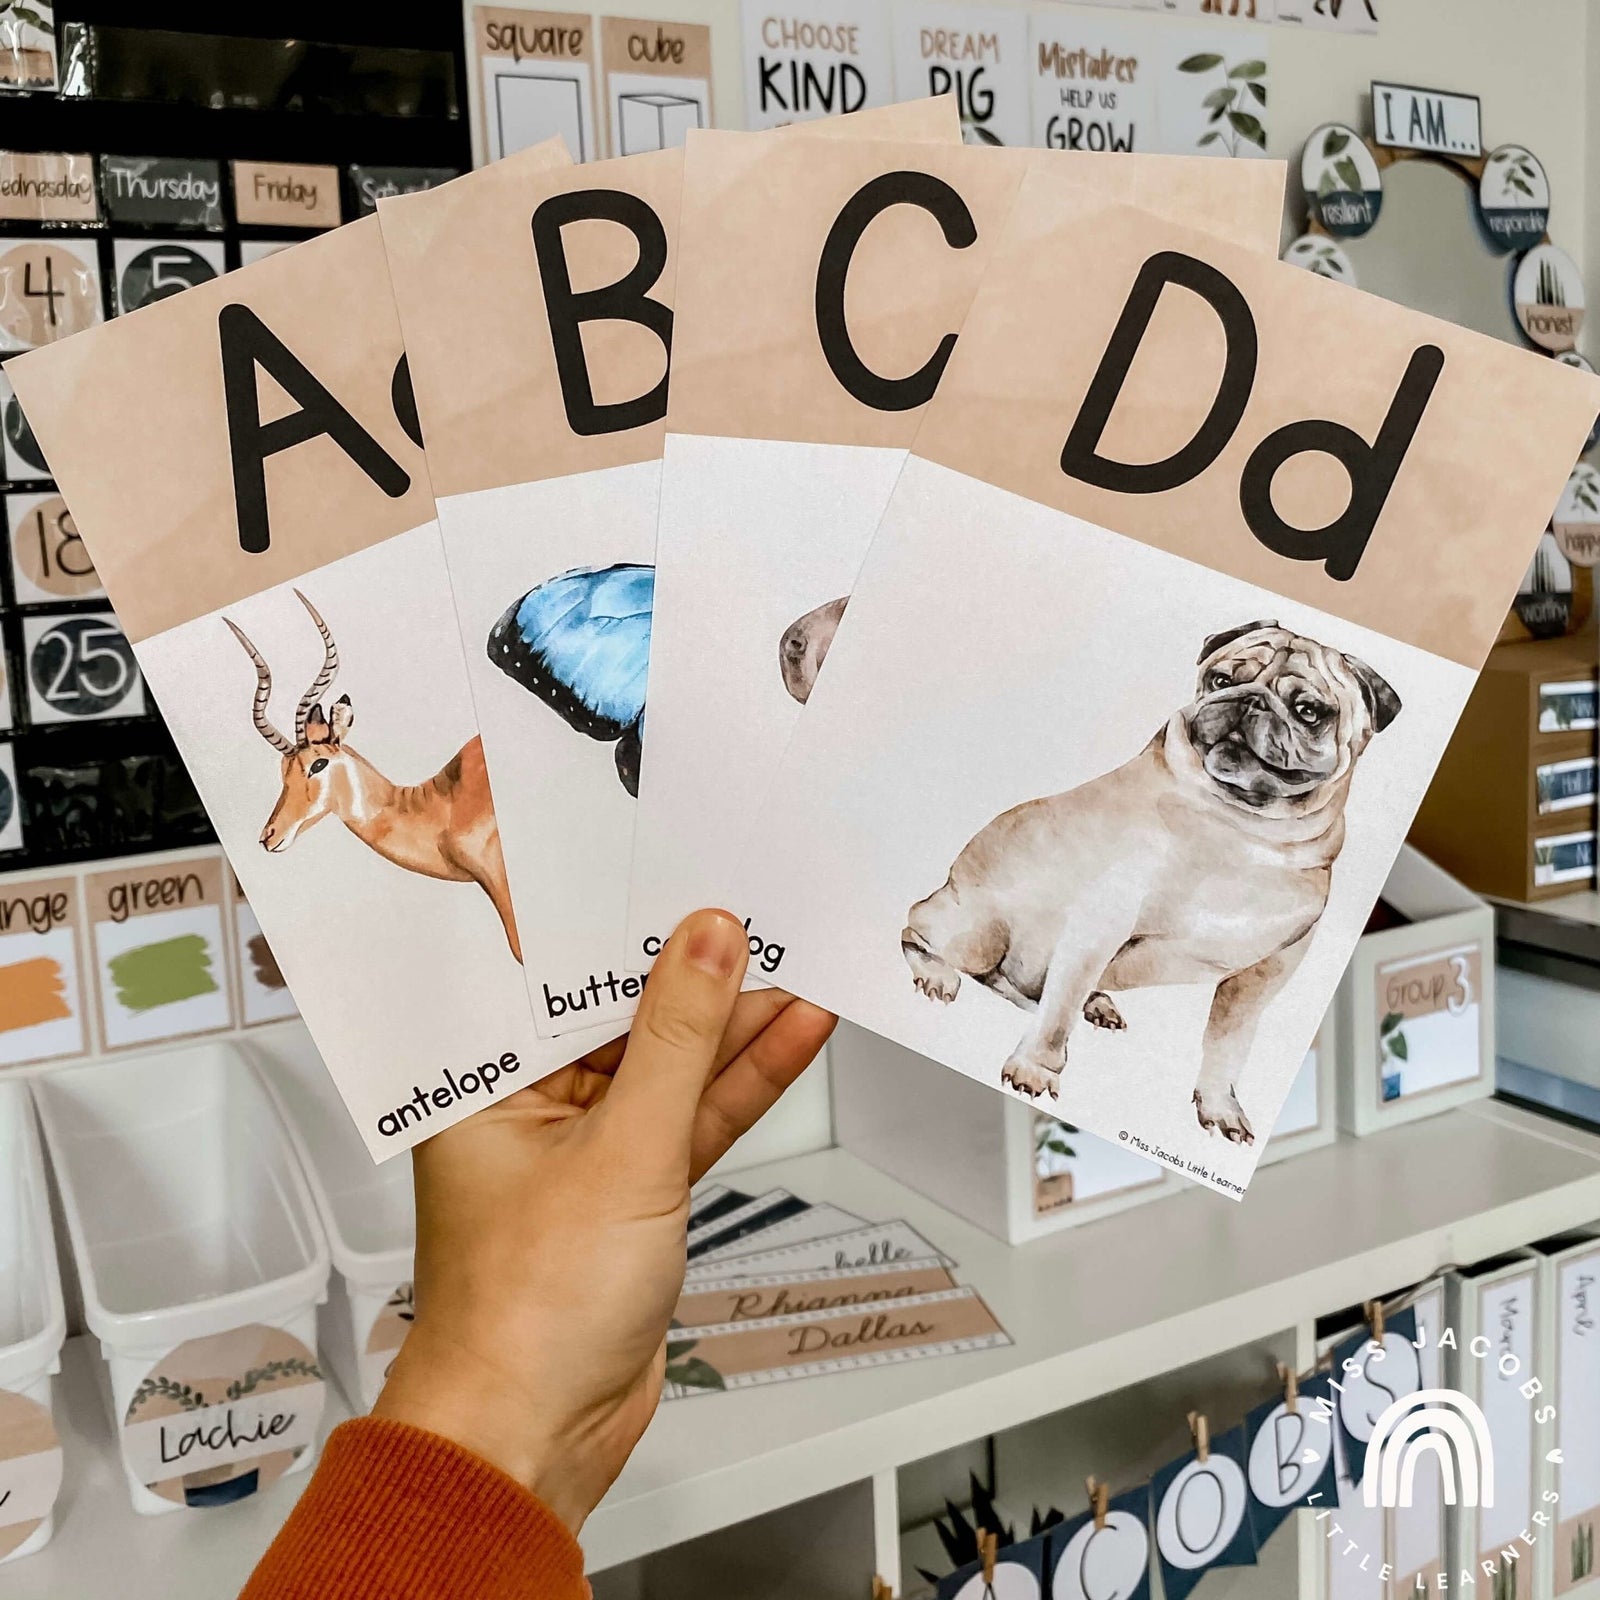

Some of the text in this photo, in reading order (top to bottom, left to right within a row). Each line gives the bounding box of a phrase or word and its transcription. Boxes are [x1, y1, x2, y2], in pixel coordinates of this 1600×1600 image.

[486, 22, 584, 64] square
[627, 27, 686, 64] cube
[762, 17, 860, 56] CHOOSE
[920, 28, 1001, 64] DREAM
[758, 56, 867, 114] KIND
[1039, 41, 1138, 84] Mistakes
[1060, 87, 1117, 110] HELP US
[1382, 92, 1396, 142] I
[1046, 115, 1134, 153] GROW
[108, 167, 220, 208] Thursday
[253, 175, 318, 210] Friday
[22, 256, 66, 327] 4
[530, 188, 675, 437] B
[814, 170, 978, 412] C
[218, 303, 425, 554] A
[1059, 250, 1446, 582] Dd
[36, 507, 96, 578] 18
[39, 627, 129, 701] 25
[0, 891, 68, 935] nge
[107, 873, 204, 923] green
[1386, 955, 1473, 1017] Group 3
[376, 1050, 521, 1138] antelope
[1130, 1136, 1149, 1152] Miss
[1150, 1145, 1184, 1168] Jacobs
[1187, 1160, 1209, 1179] Little
[787, 1315, 936, 1355] Dallas
[159, 1408, 298, 1465] Lachie
